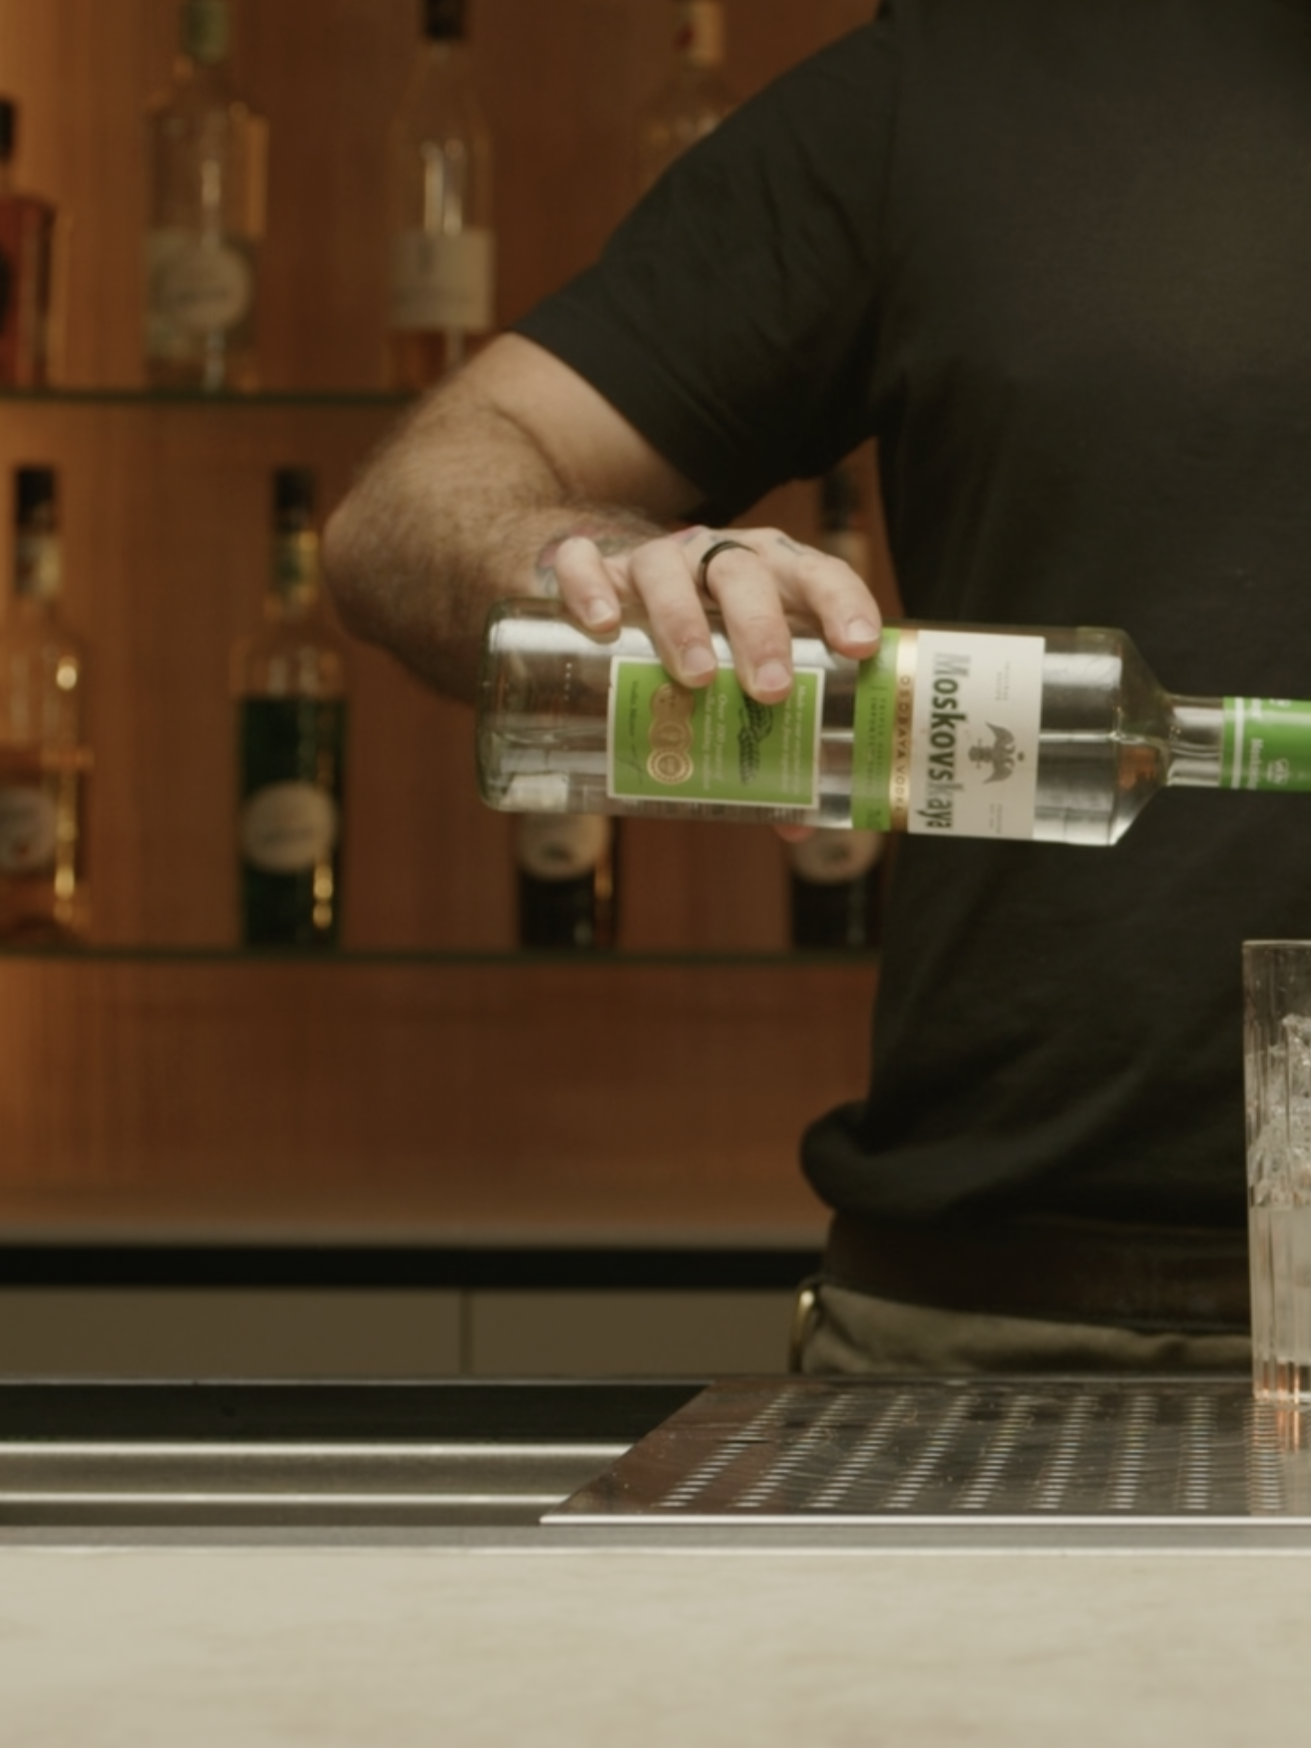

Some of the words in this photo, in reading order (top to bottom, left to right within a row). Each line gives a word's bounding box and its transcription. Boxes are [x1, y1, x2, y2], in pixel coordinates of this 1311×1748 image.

[717, 693, 728, 720] Over
[897, 675, 912, 759] OSOBAYA
[716, 723, 727, 743] 100
[917, 652, 971, 829] Moskovskaya
[894, 765, 906, 813] VODKA
